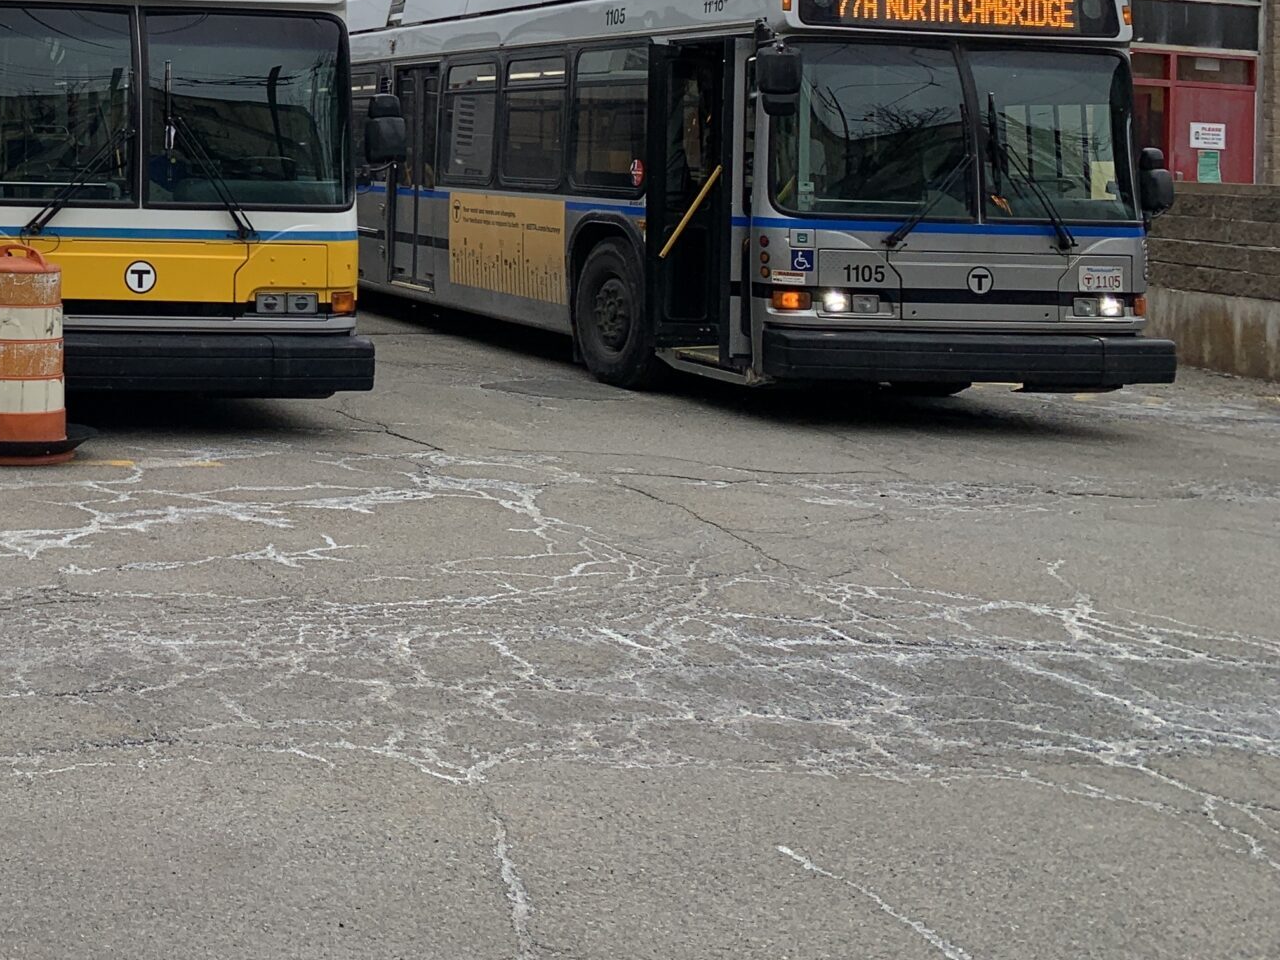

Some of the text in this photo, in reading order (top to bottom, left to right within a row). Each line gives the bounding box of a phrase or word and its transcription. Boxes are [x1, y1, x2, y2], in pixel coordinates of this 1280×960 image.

[605, 8, 626, 26] 1105
[843, 264, 885, 283] 1105
[1096, 275, 1121, 289] 1105
